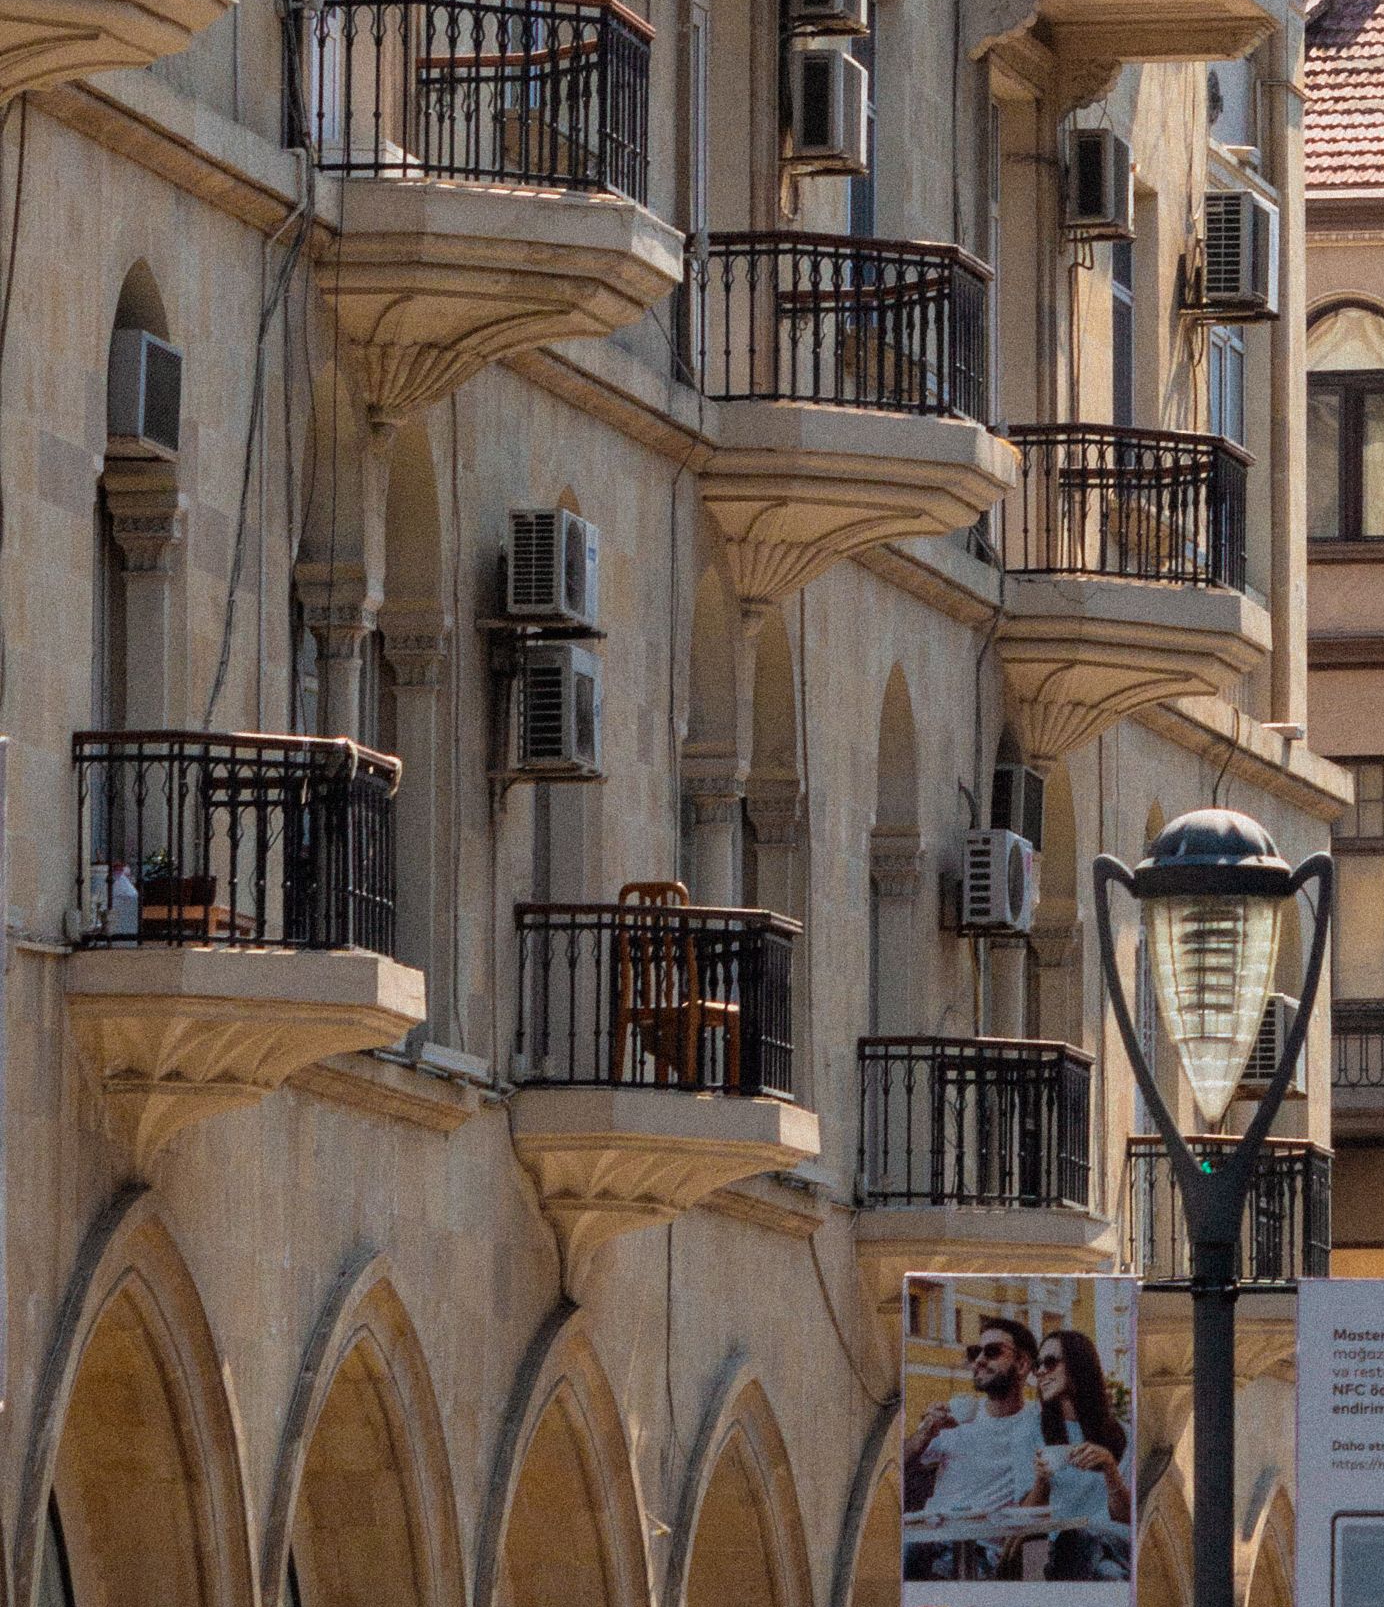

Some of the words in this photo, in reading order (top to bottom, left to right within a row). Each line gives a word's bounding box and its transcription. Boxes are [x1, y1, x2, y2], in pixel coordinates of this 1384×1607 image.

[1333, 1369, 1349, 1379] və
[1333, 1384, 1366, 1396] NFC
[1333, 1440, 1365, 1451] Daha
